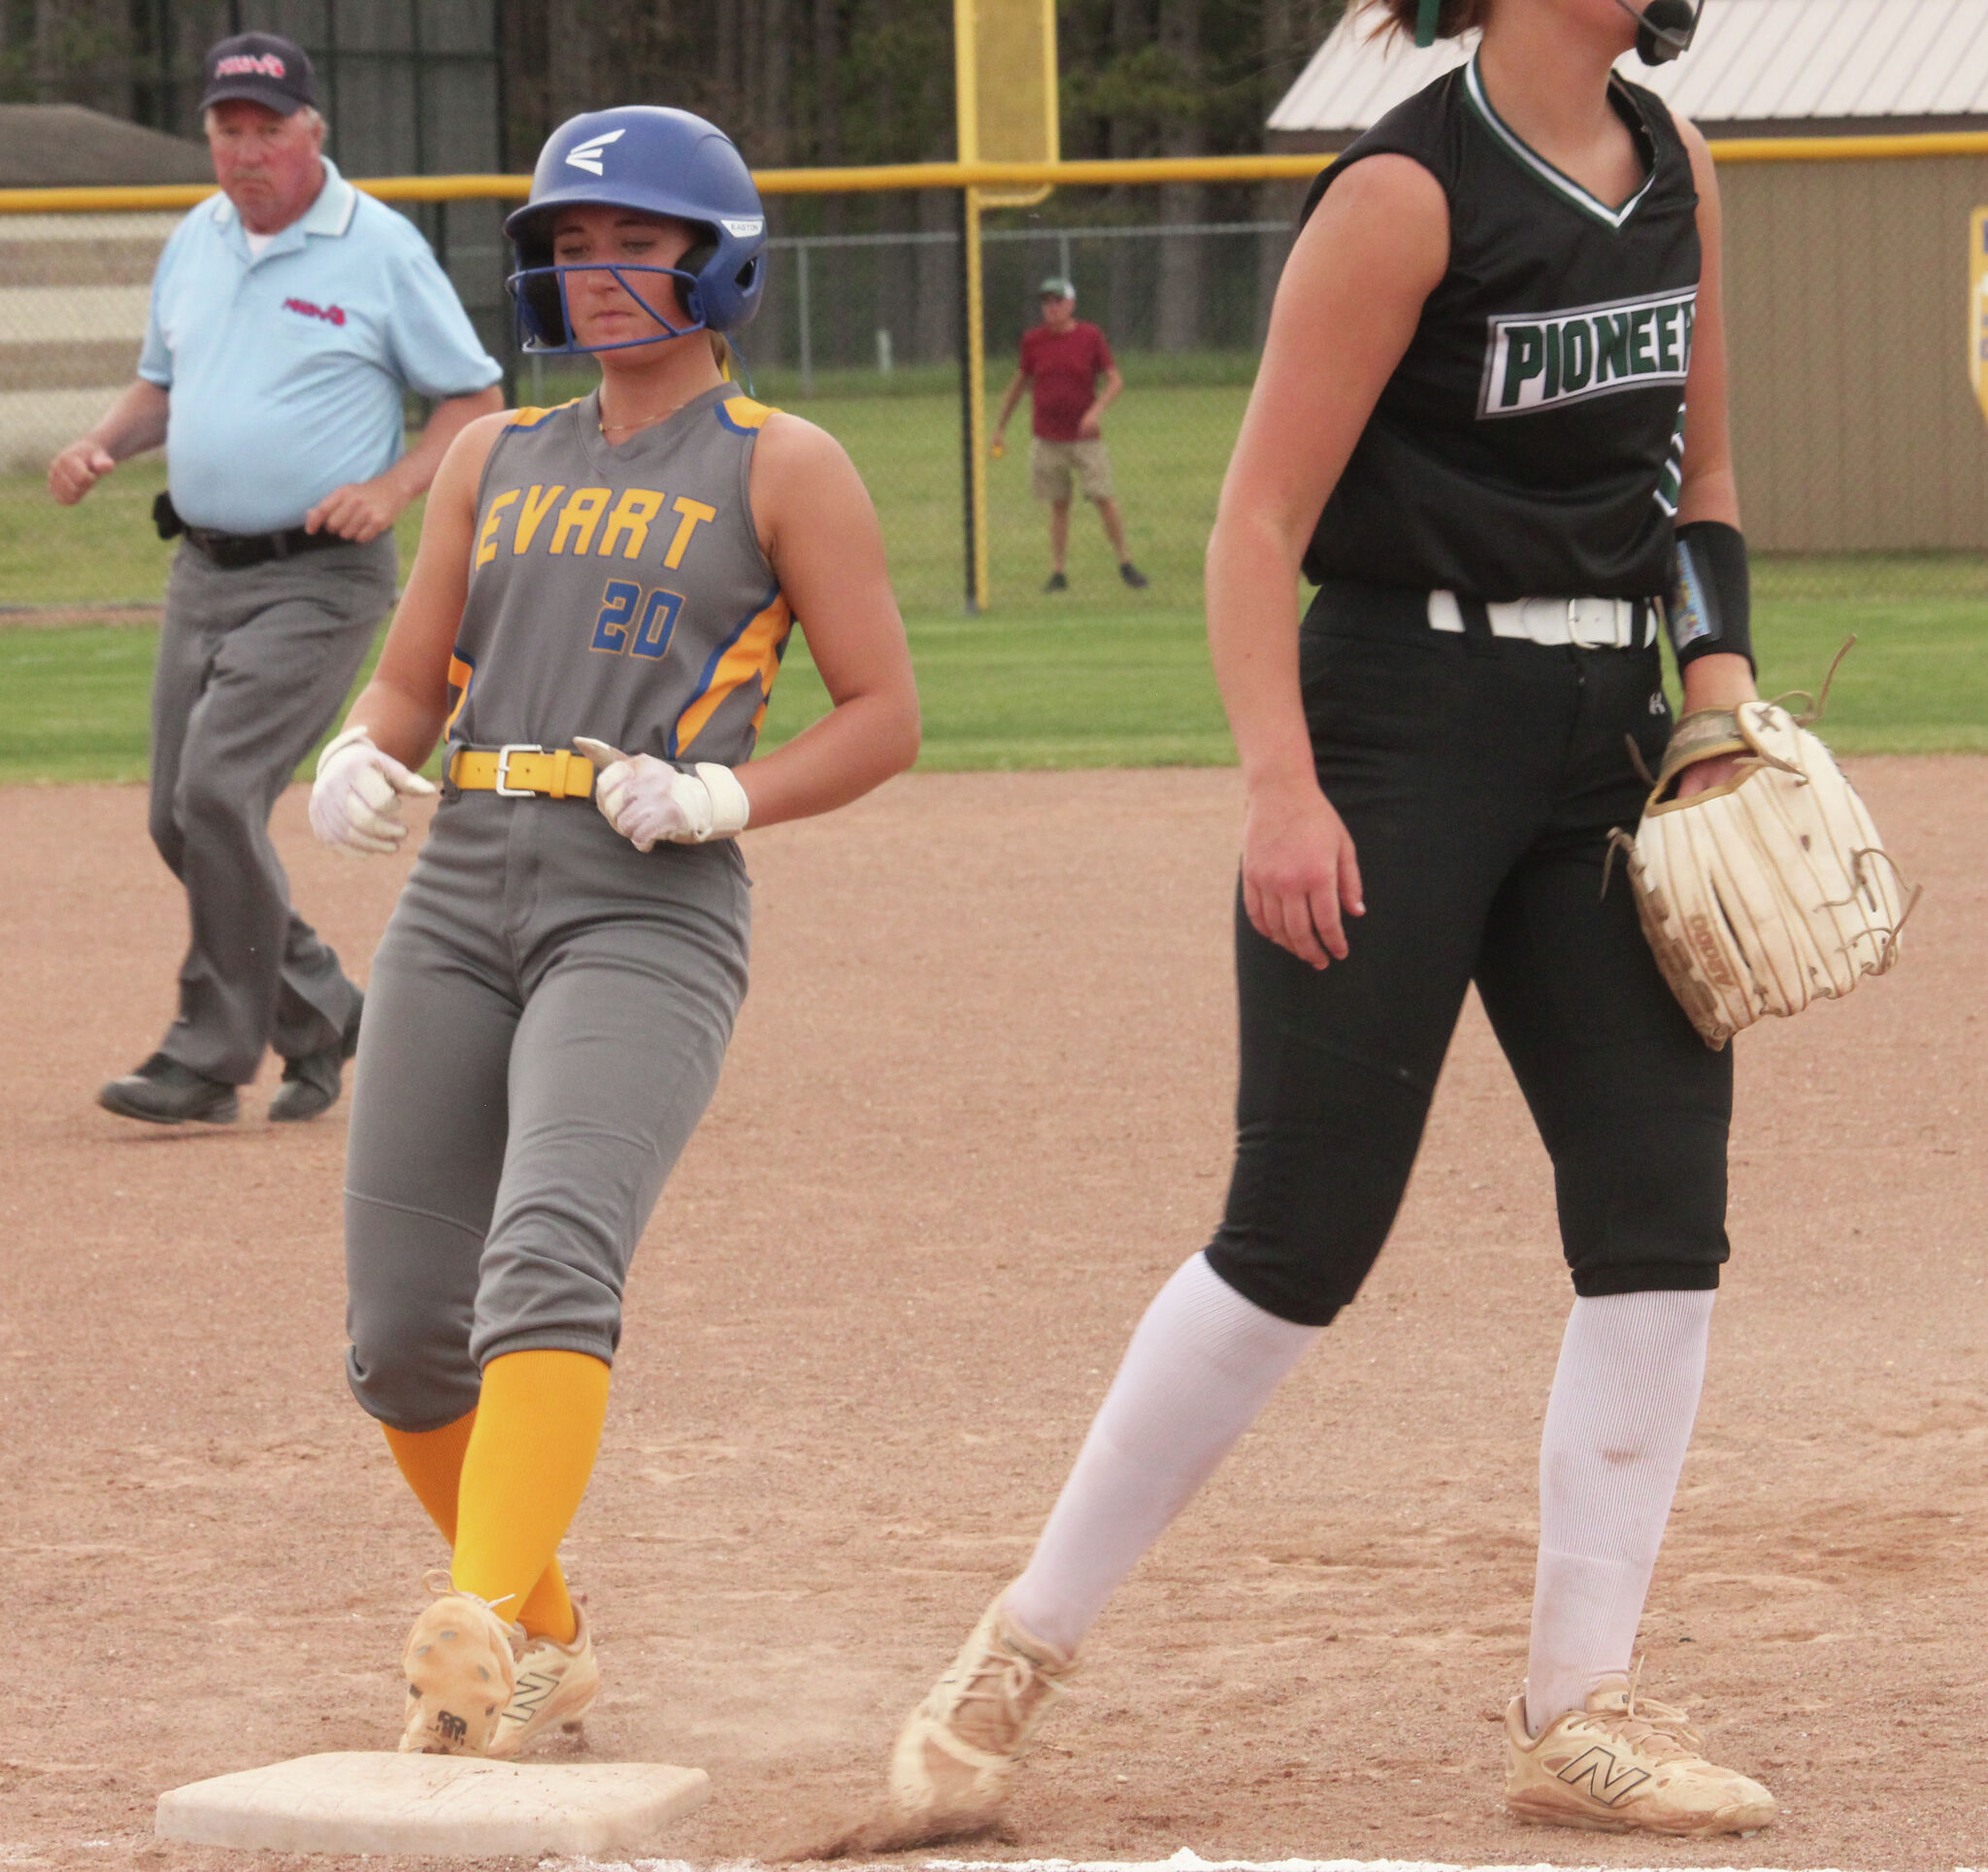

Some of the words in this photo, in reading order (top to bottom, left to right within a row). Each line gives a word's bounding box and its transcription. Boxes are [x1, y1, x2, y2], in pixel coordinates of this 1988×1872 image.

[475, 485, 717, 571] EVART
[588, 578, 687, 661] 20
[1556, 1745, 1652, 1806] N
